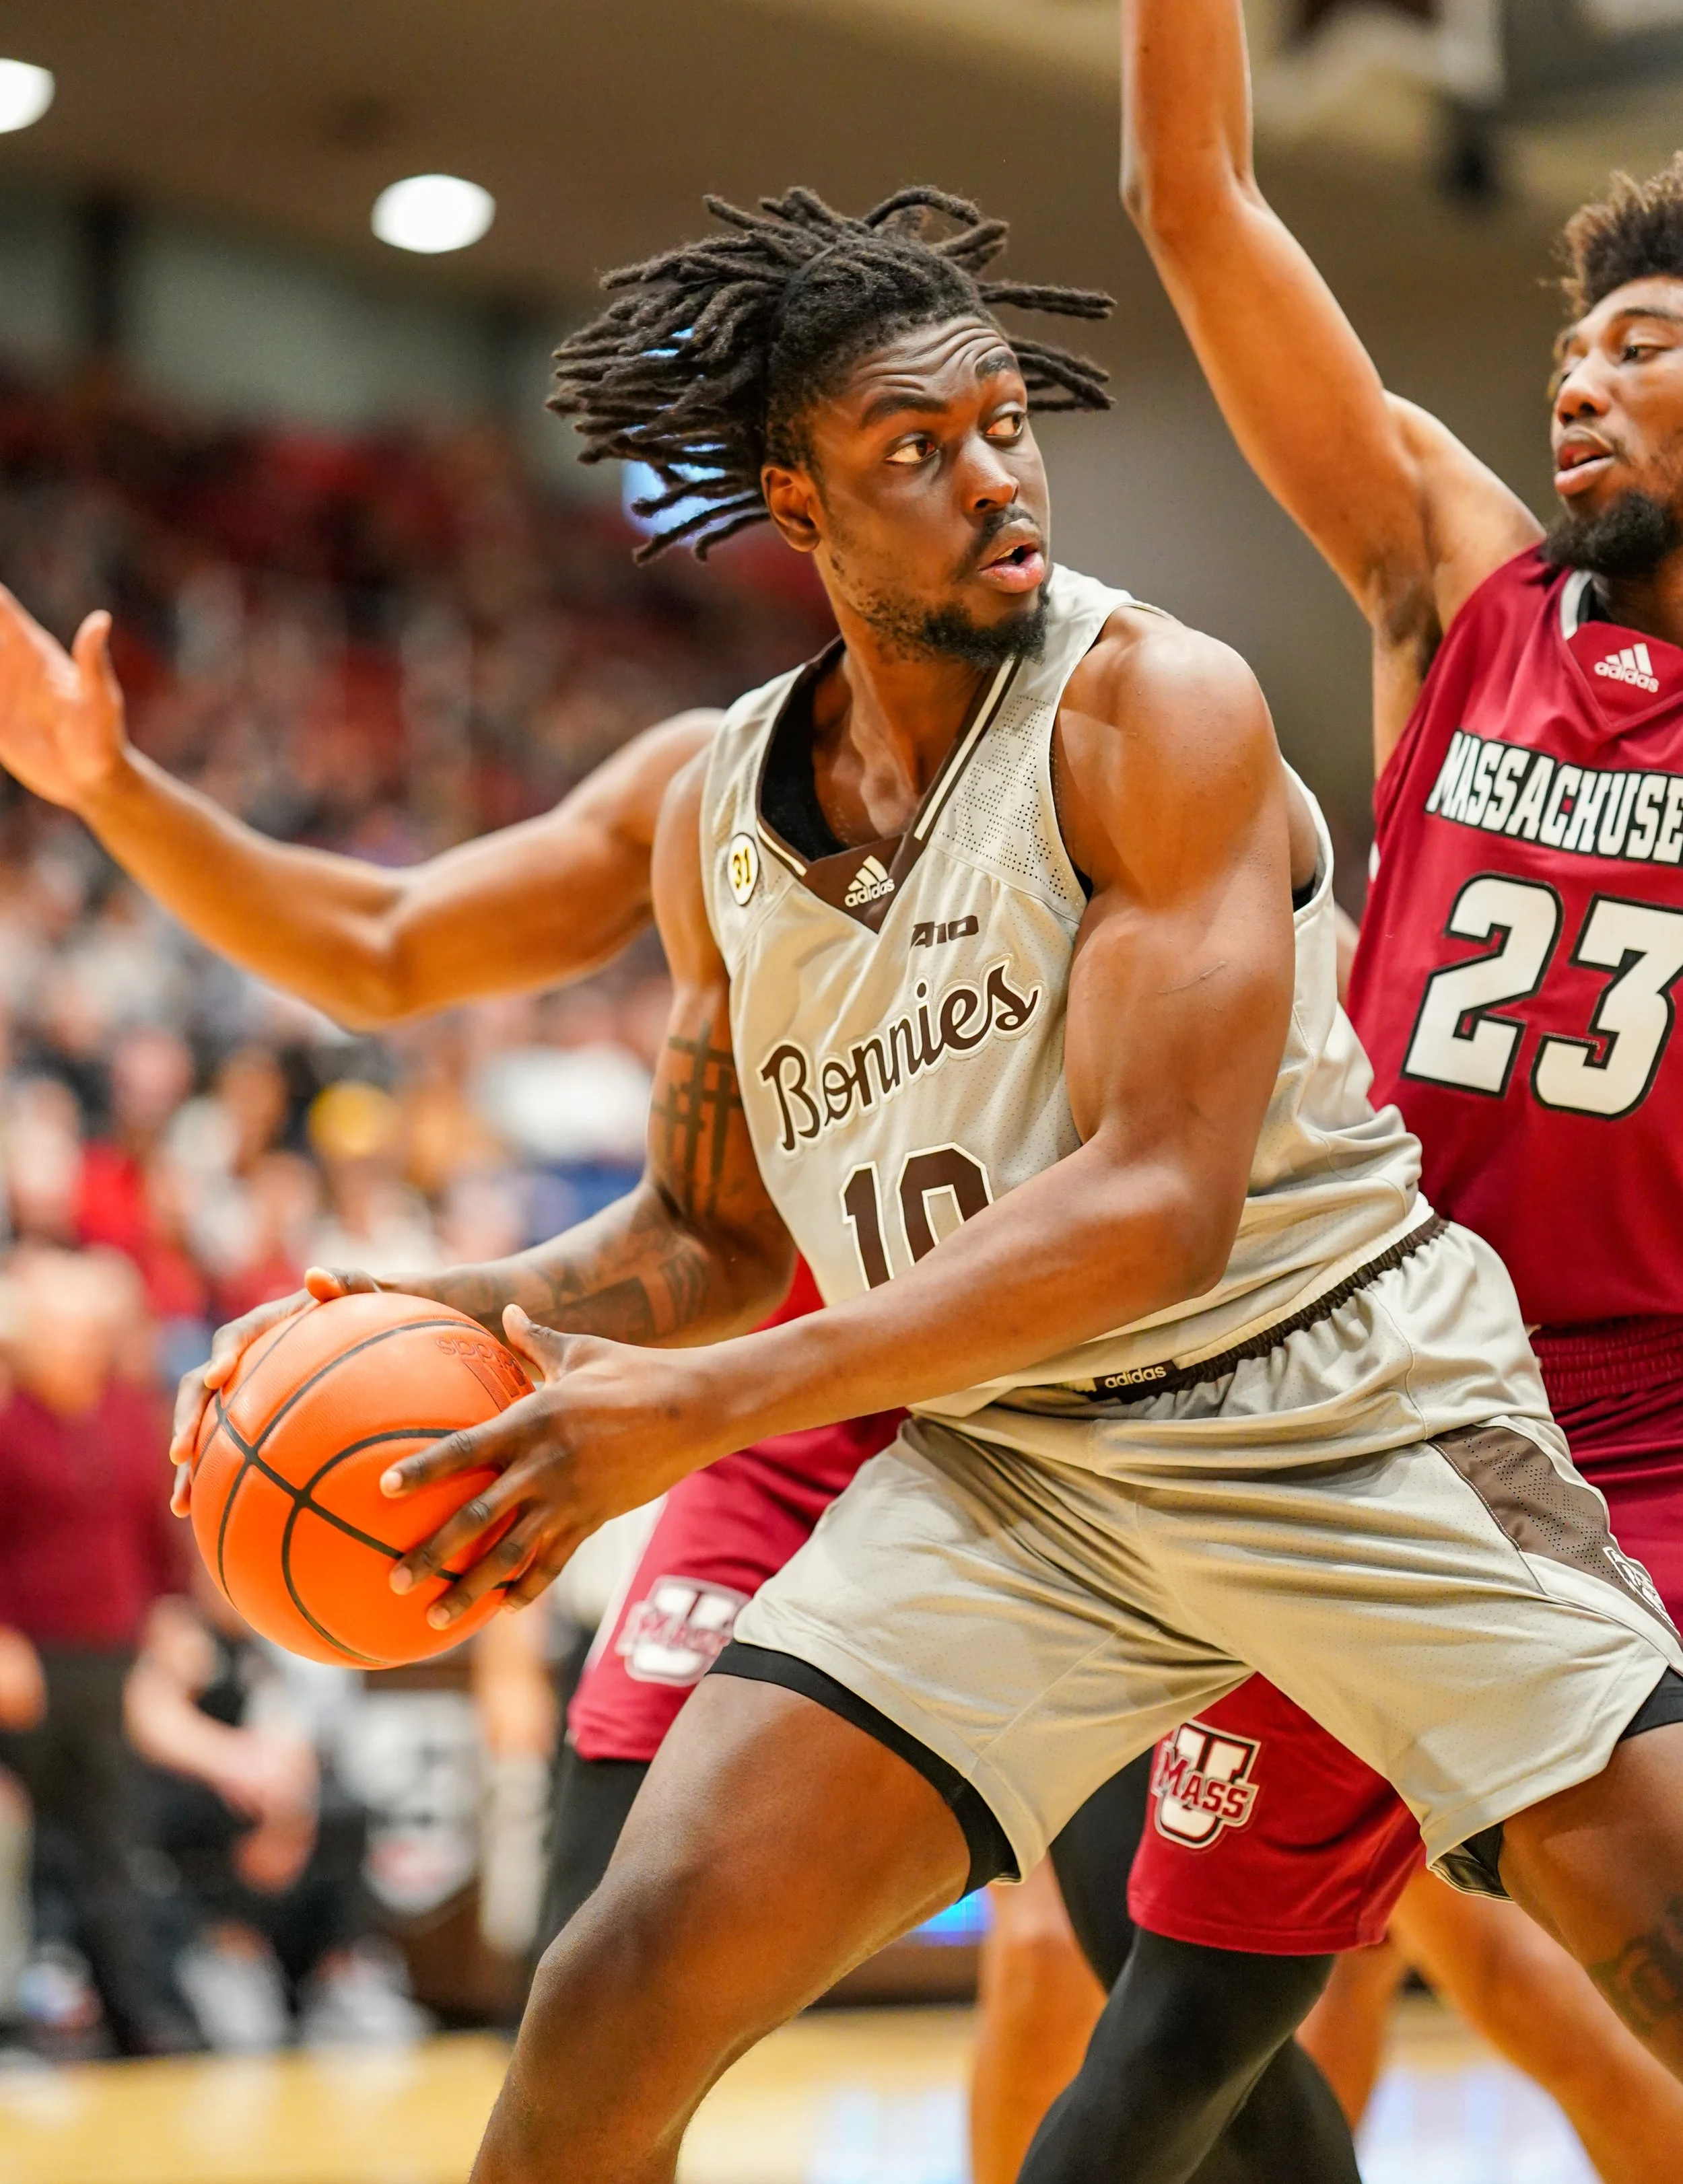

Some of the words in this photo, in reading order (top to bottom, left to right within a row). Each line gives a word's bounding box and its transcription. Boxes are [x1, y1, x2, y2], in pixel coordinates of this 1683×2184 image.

[1593, 661, 1659, 693] adidas
[1424, 730, 1683, 865] MASSACHUSE
[732, 846, 751, 890] 31
[844, 877, 895, 908] adidas
[1402, 872, 1683, 1119] 23
[760, 962, 1041, 1154] Bonnies
[839, 1142, 994, 1291] 10
[435, 1337, 522, 1377] didas
[1104, 1365, 1167, 1389] adidas
